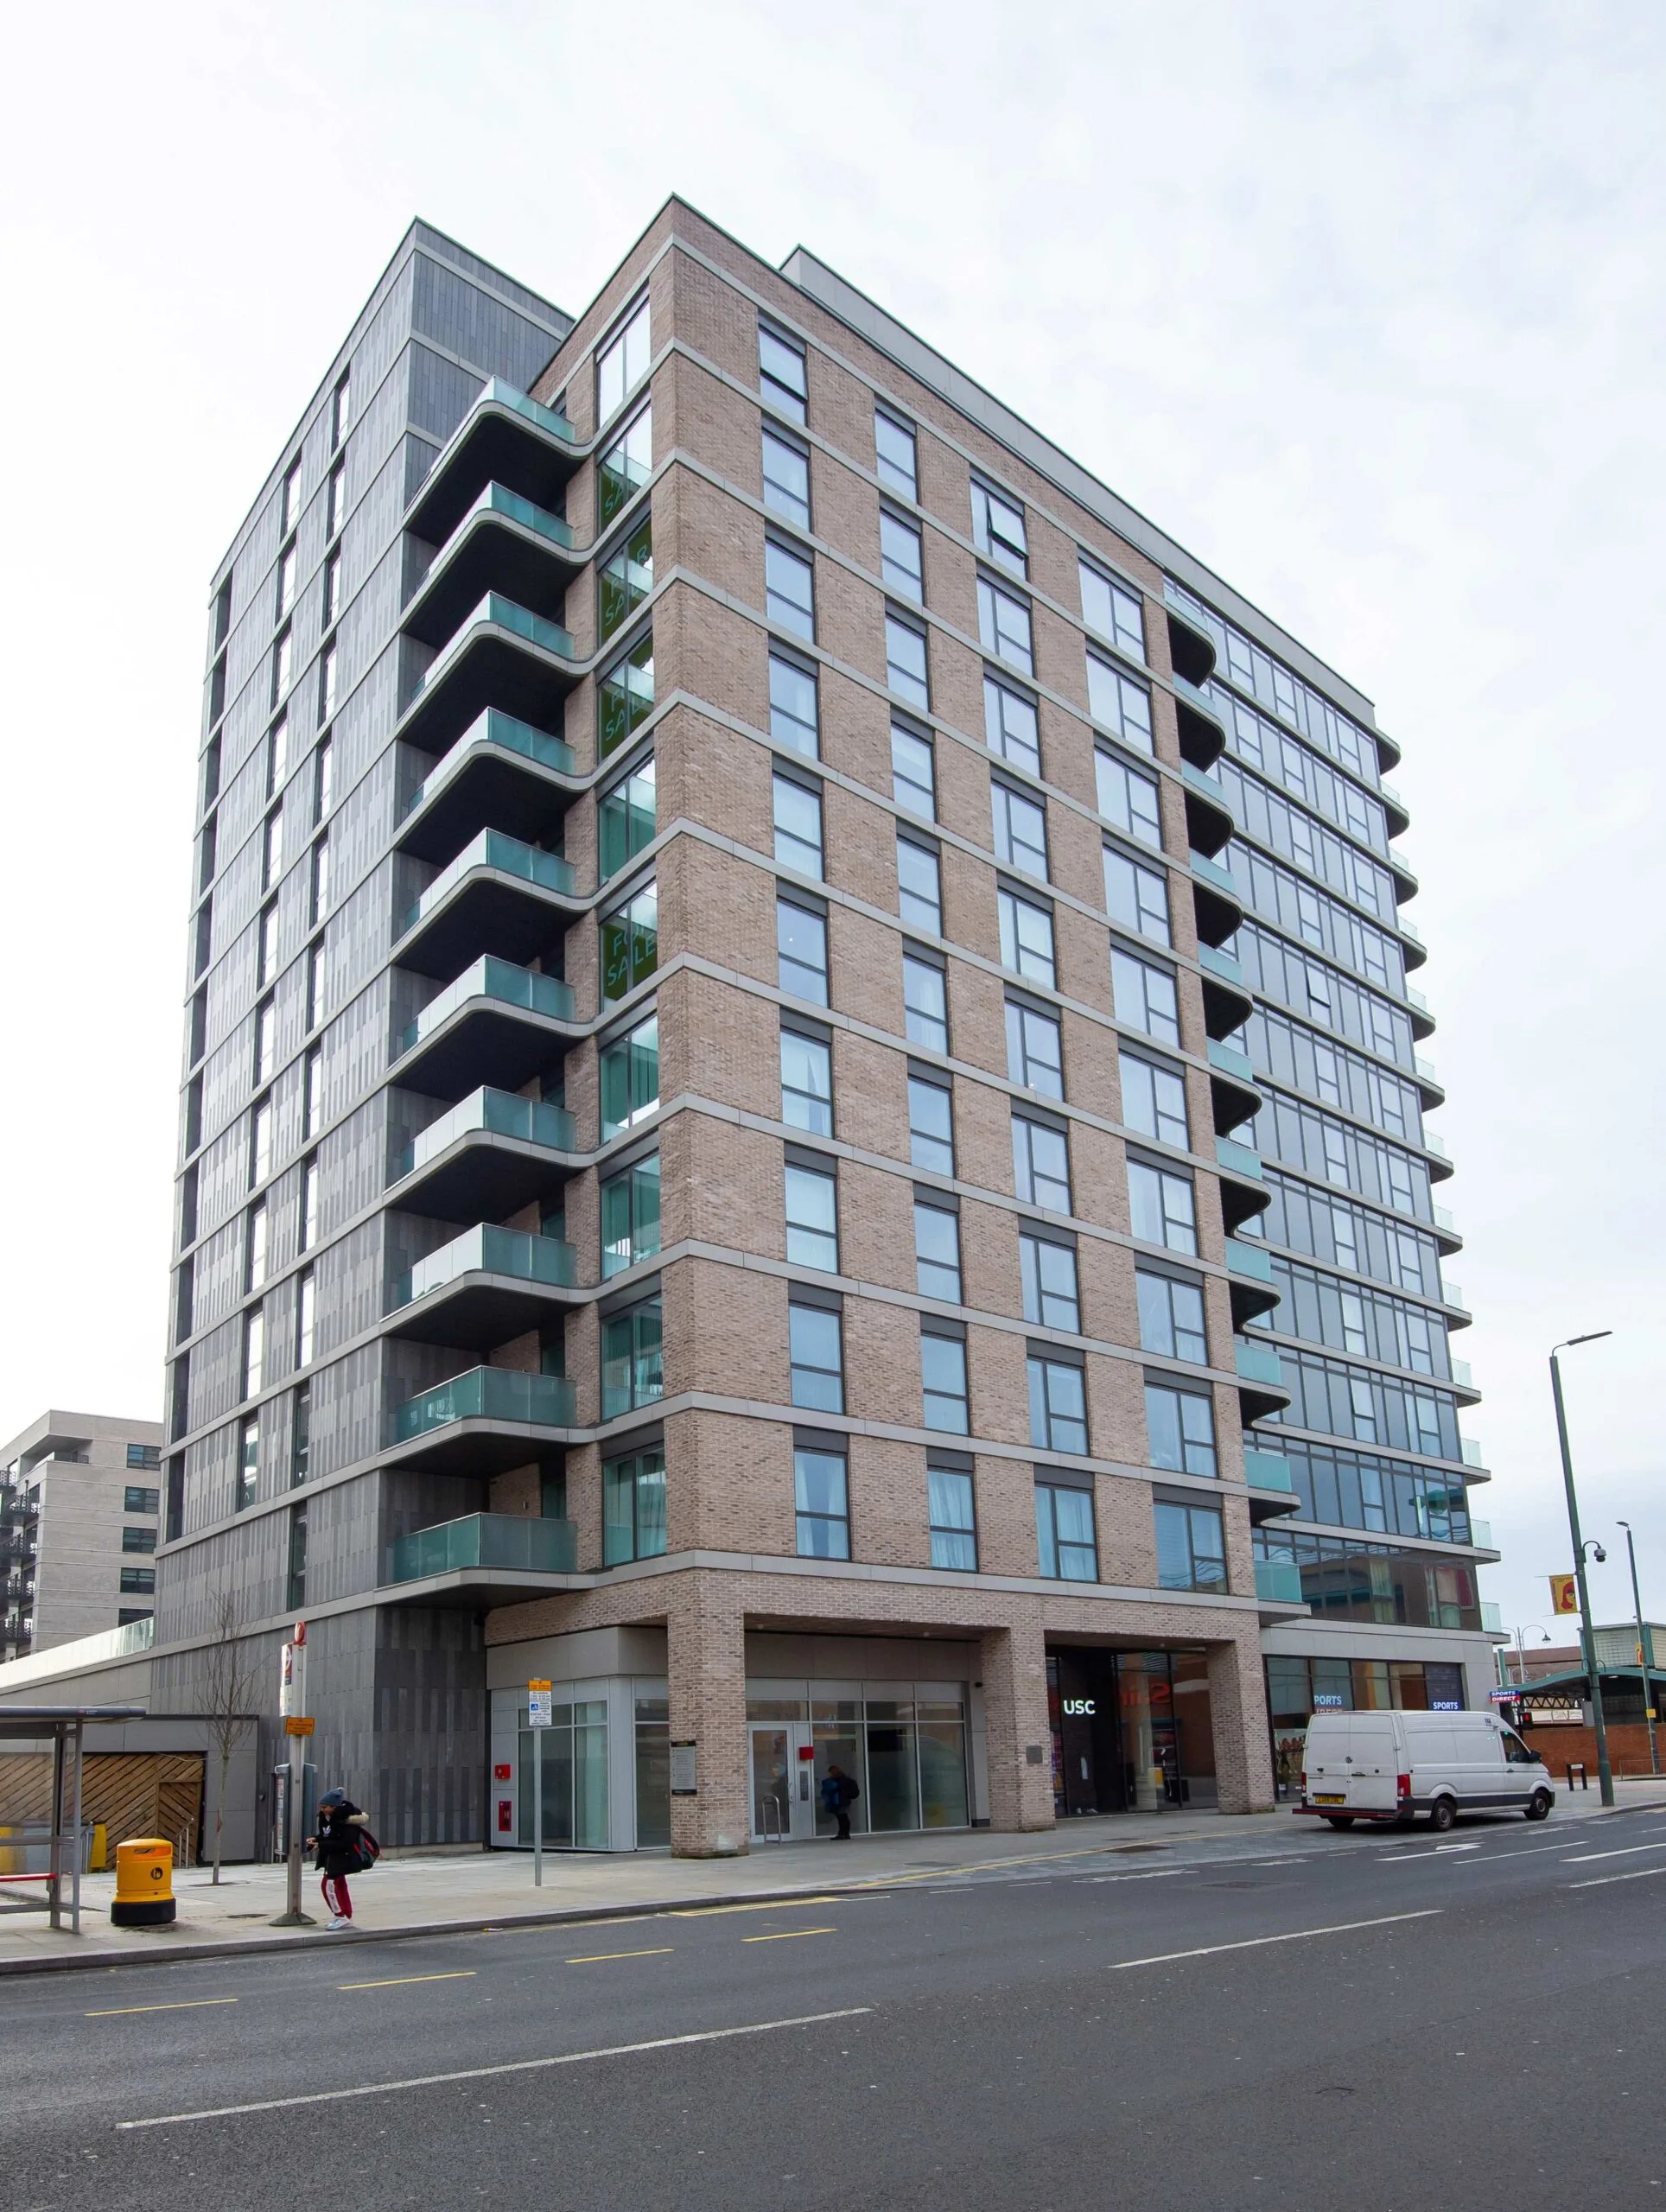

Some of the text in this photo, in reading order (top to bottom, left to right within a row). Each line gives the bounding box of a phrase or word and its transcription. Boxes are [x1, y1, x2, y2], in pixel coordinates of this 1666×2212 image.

[607, 932, 658, 986] SALE
[1313, 1694, 1342, 1706] PORTS
[1433, 1701, 1459, 1710] SPORTS
[1063, 1700, 1096, 1715] USC
